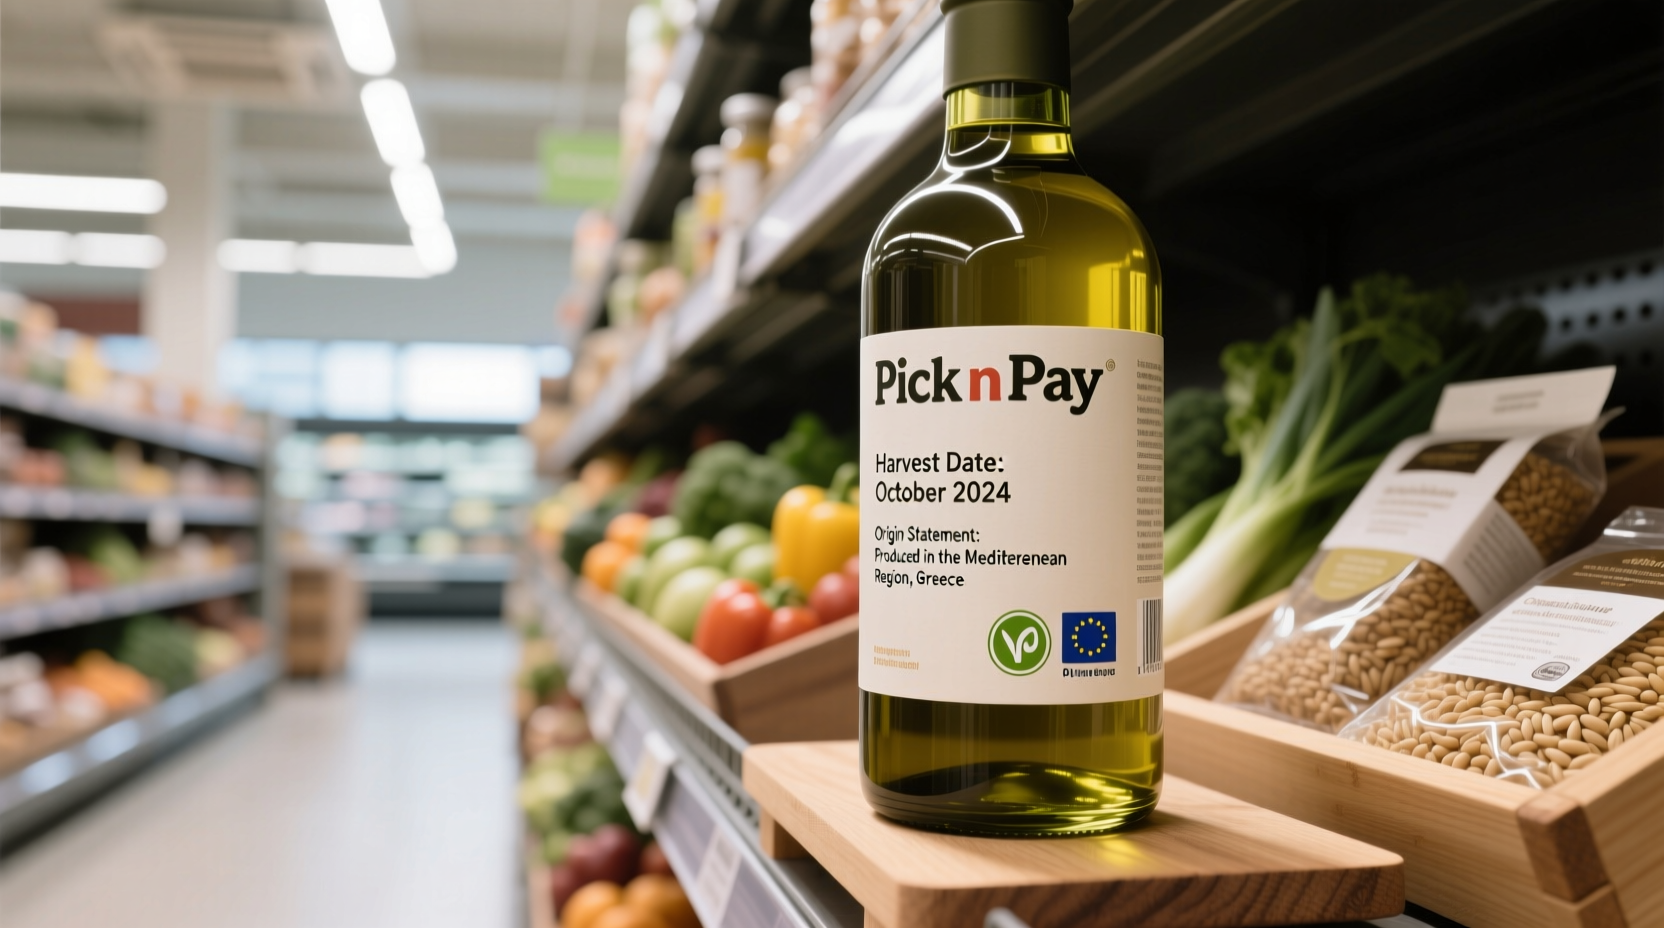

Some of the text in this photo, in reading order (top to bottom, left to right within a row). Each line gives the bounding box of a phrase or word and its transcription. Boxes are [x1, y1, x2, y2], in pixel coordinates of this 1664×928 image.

[875, 354, 1103, 415] Pick n Pay
[876, 452, 1004, 473] Harvest Date:
[876, 481, 1011, 503] October 2024
[875, 526, 980, 545] Origin Statement:
[875, 548, 1067, 567] Produced in the Mediterenean
[916, 570, 965, 587] Greece
